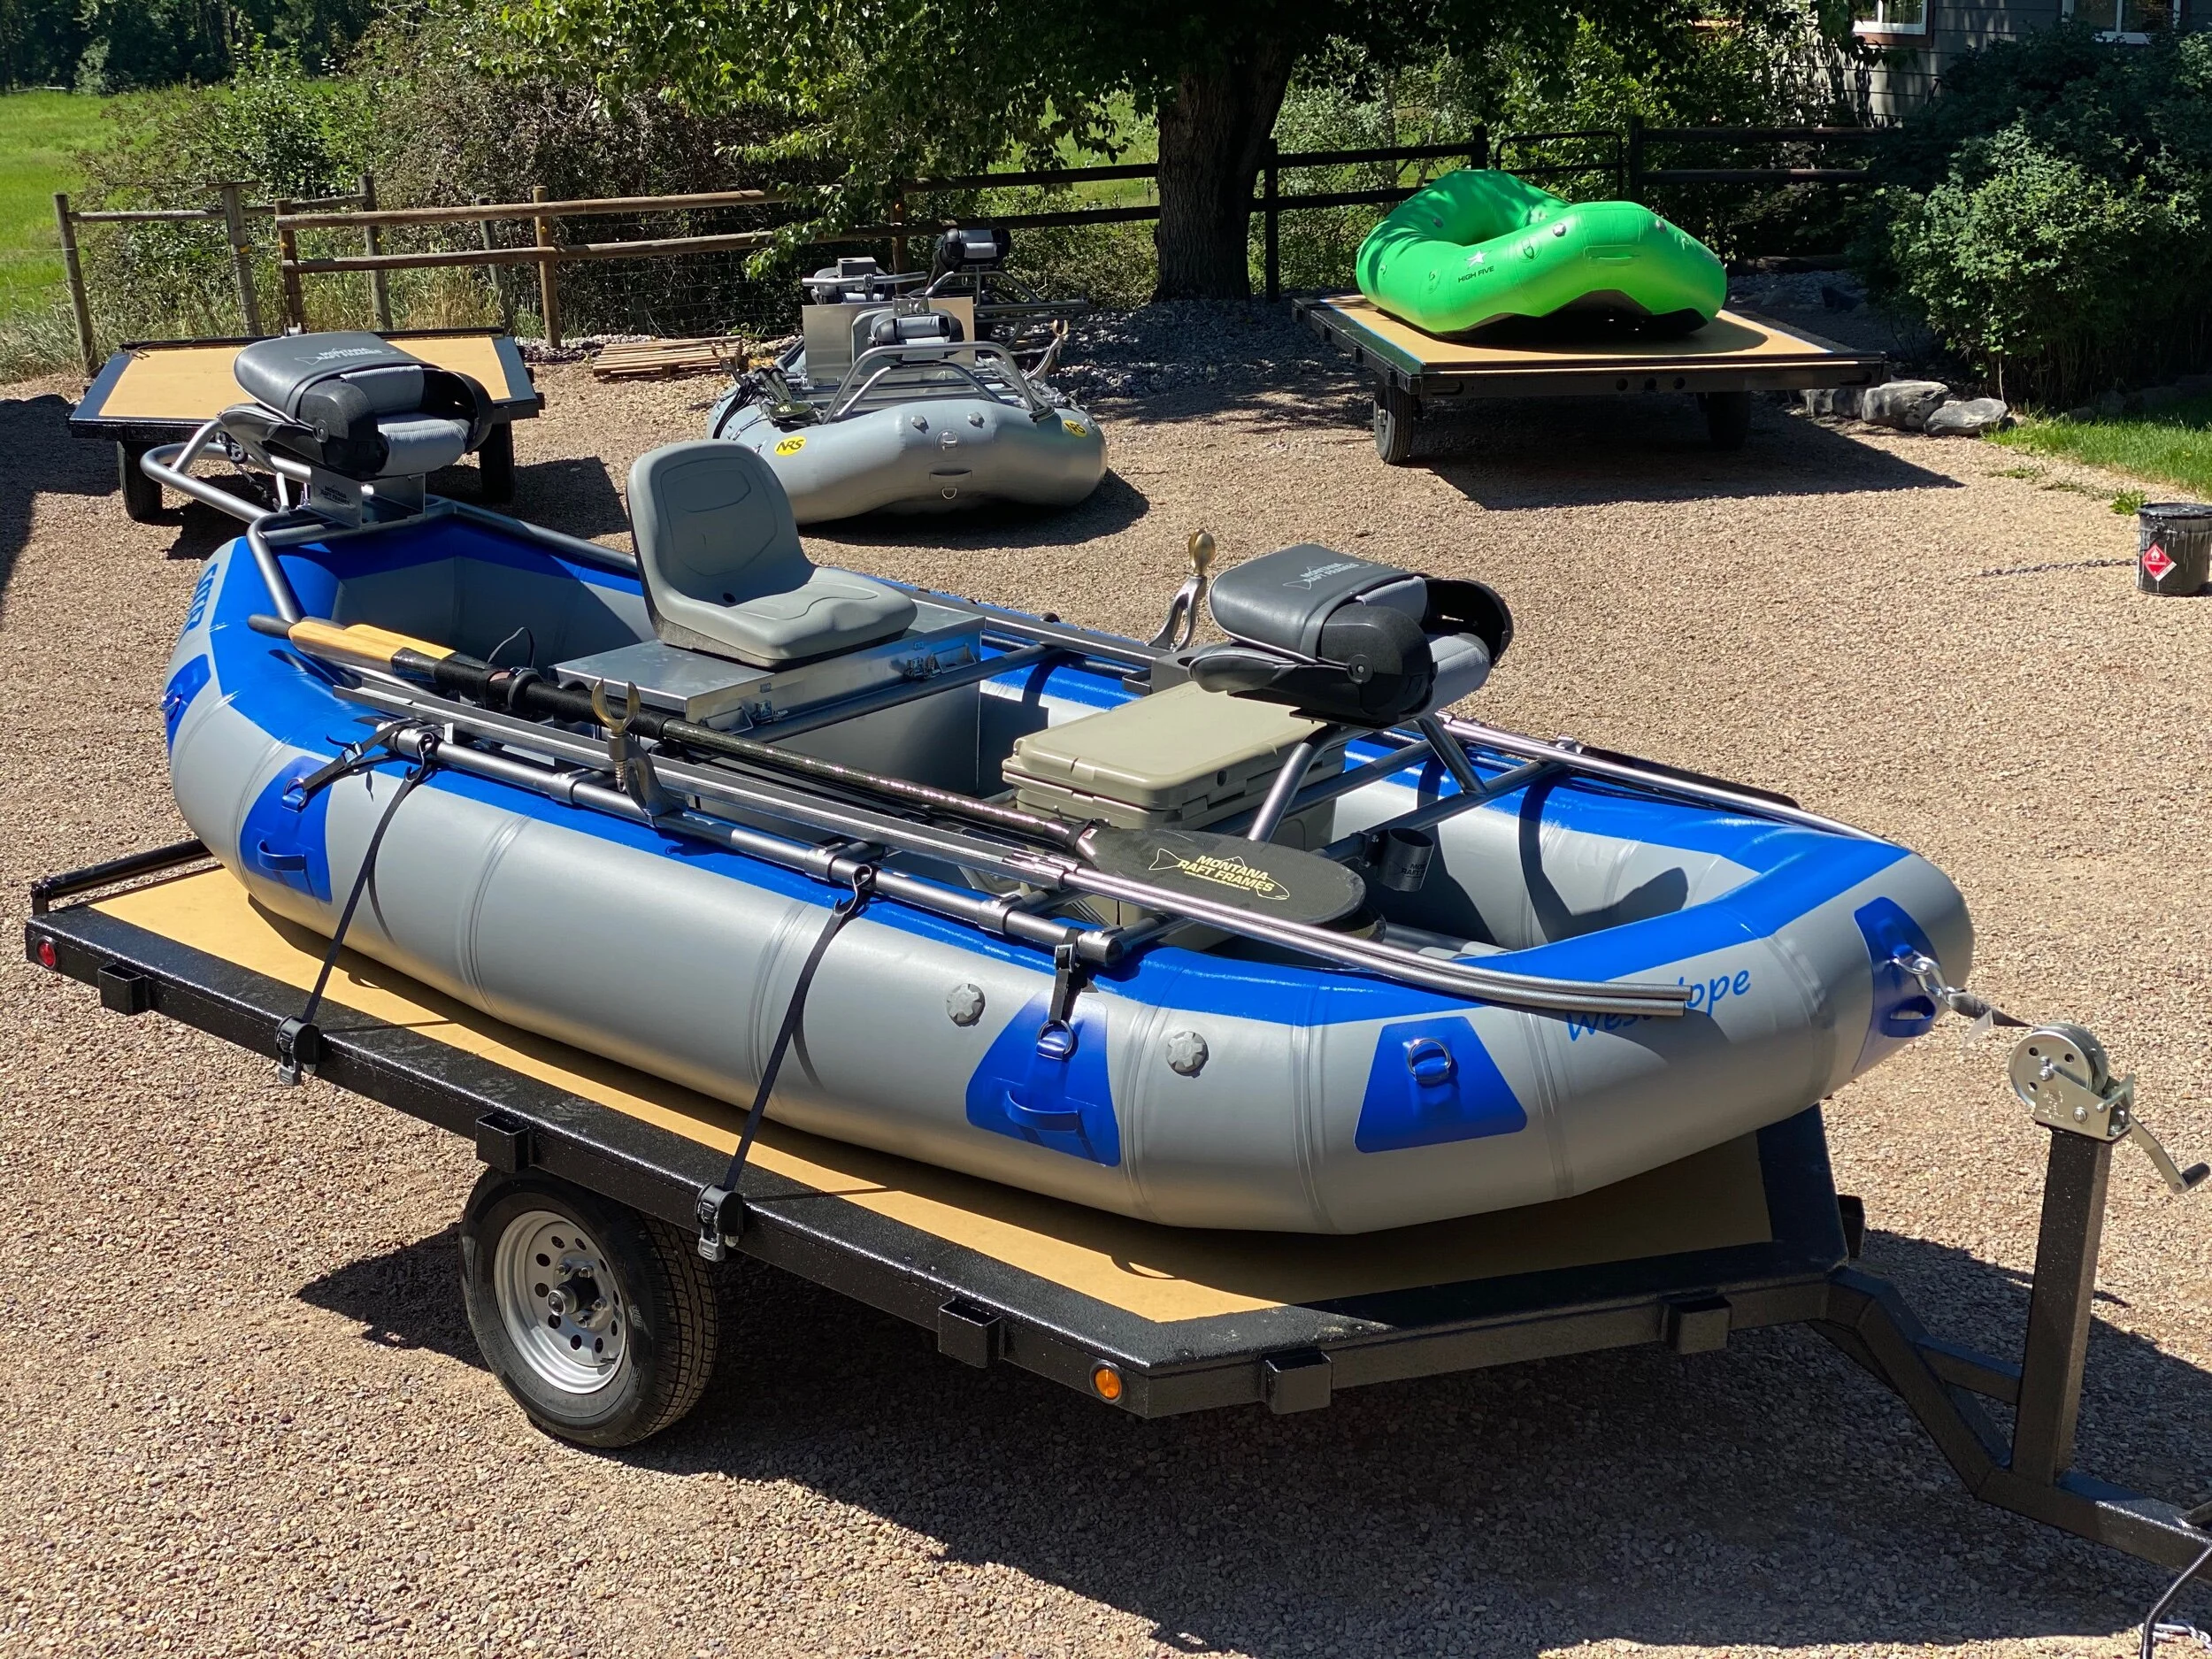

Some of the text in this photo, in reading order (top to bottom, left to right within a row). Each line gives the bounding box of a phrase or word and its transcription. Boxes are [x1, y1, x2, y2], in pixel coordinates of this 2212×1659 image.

[1457, 265, 1494, 283] HIGH FIVE
[1064, 422, 1087, 434] NRS
[776, 439, 804, 452] NRS
[1177, 859, 1215, 877] RAFT
[1215, 870, 1275, 892] FRAMES
[1195, 855, 1269, 881] MONTANA
[1566, 970, 1751, 1041] Wesope
